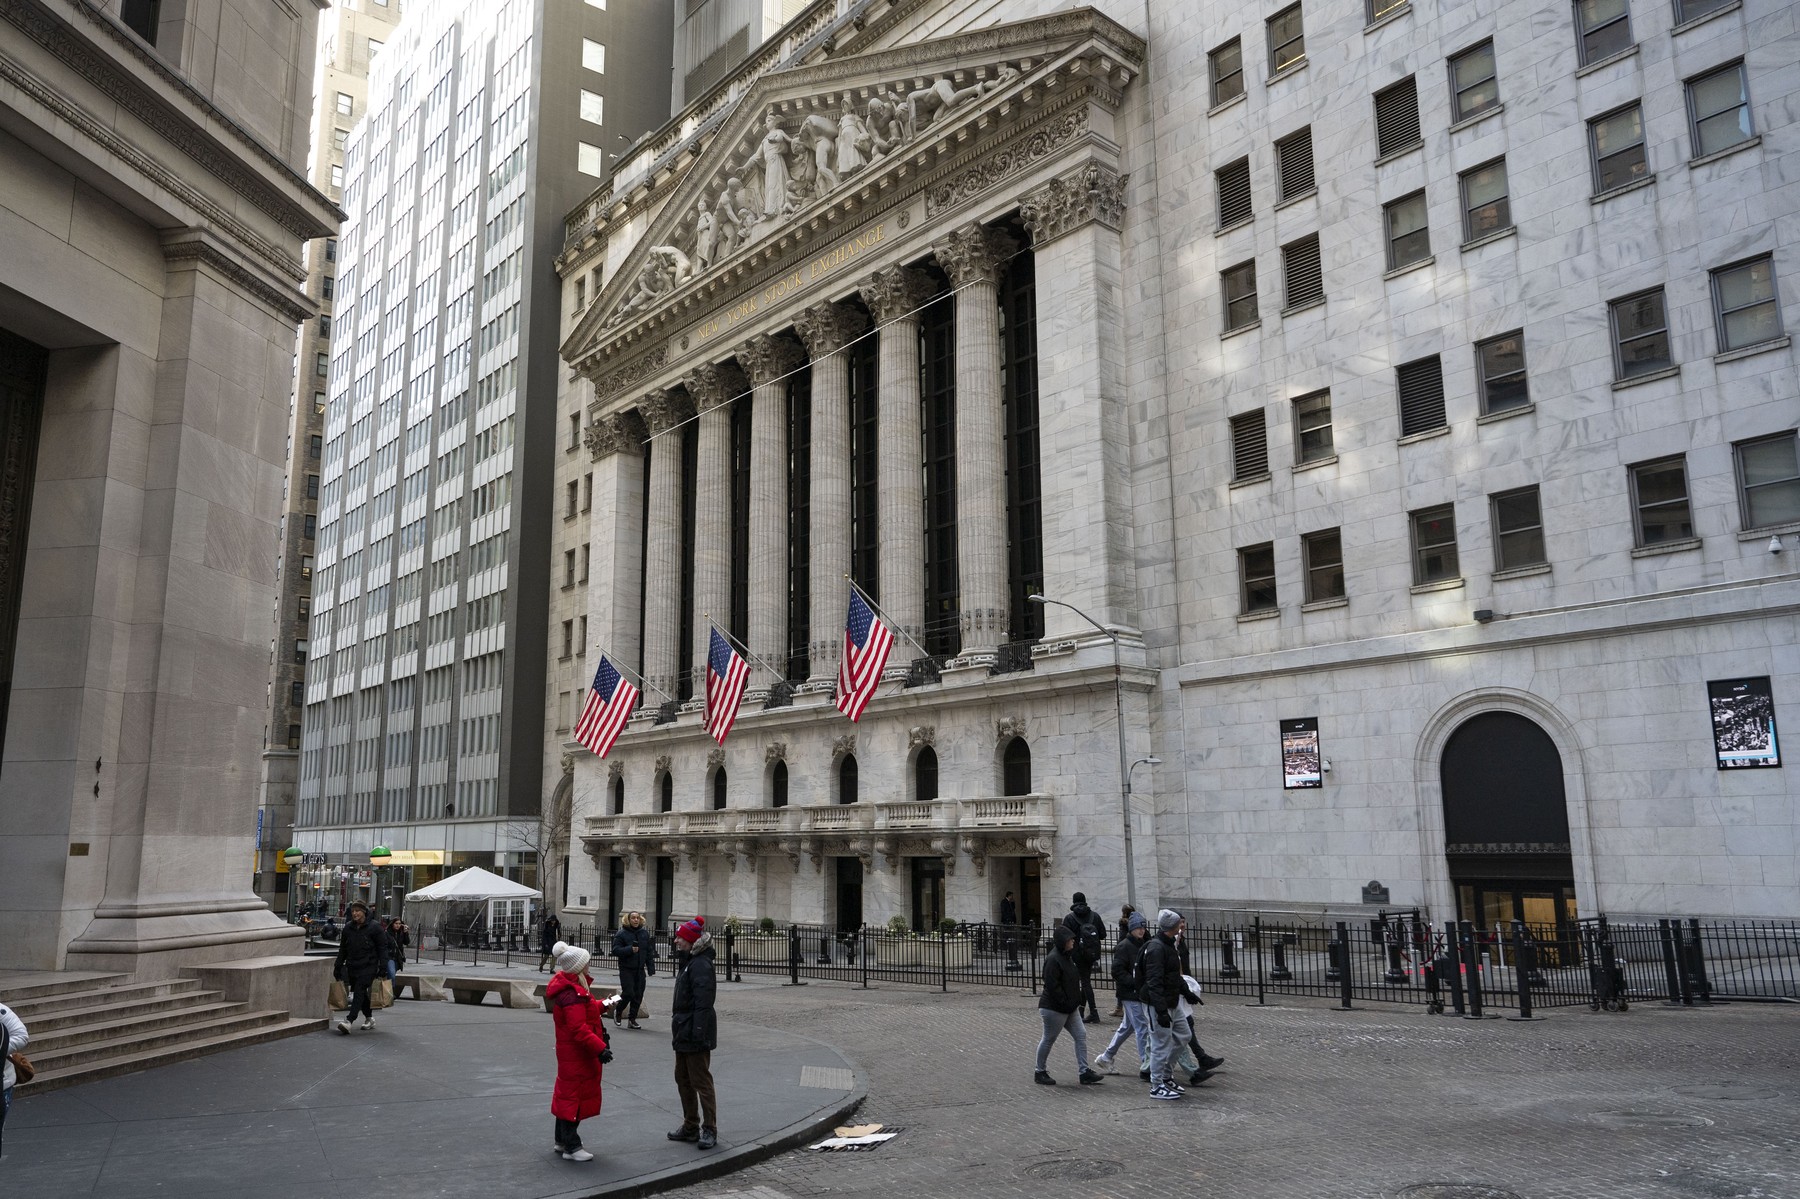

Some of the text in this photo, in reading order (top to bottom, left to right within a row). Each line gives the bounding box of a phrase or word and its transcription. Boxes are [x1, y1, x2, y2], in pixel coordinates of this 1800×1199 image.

[698, 224, 884, 341] NEW YORK STOCK EXCHANGE
